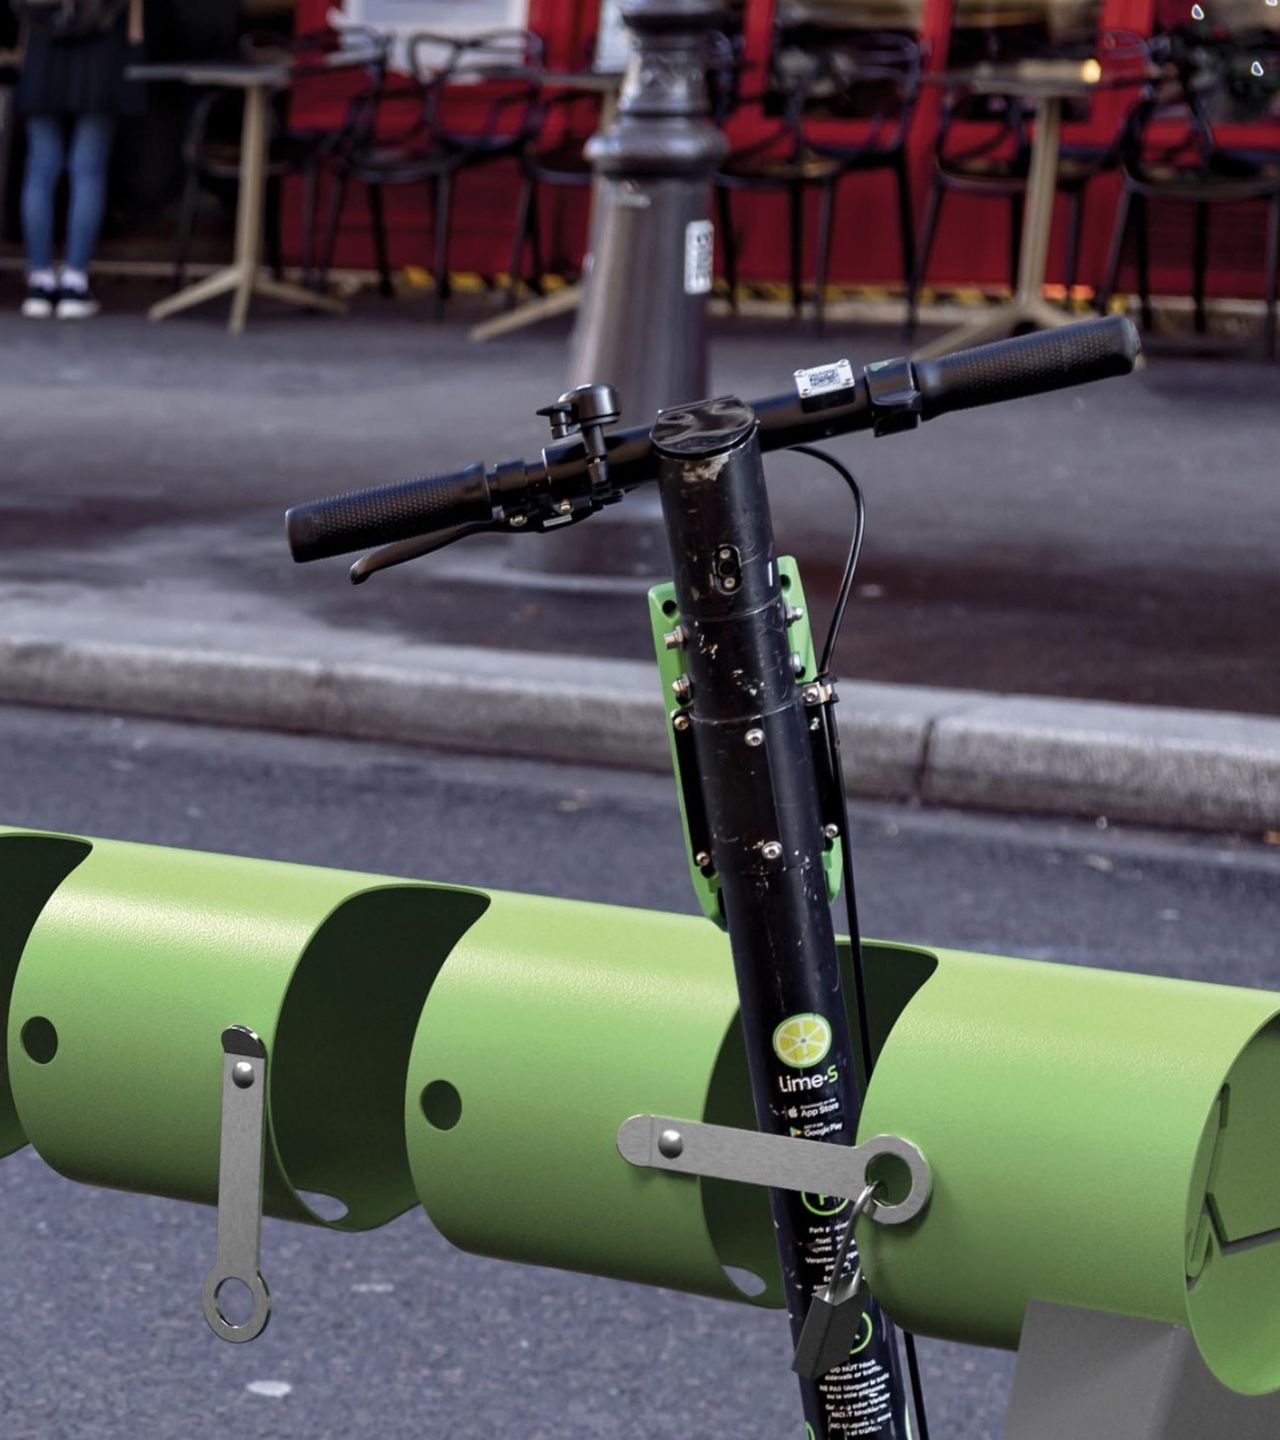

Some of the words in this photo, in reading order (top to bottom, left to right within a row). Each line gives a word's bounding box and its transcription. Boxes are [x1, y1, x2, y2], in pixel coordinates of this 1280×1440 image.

[801, 1109, 818, 1118] App
[819, 1102, 839, 1114] Store
[804, 1126, 830, 1137] Google
